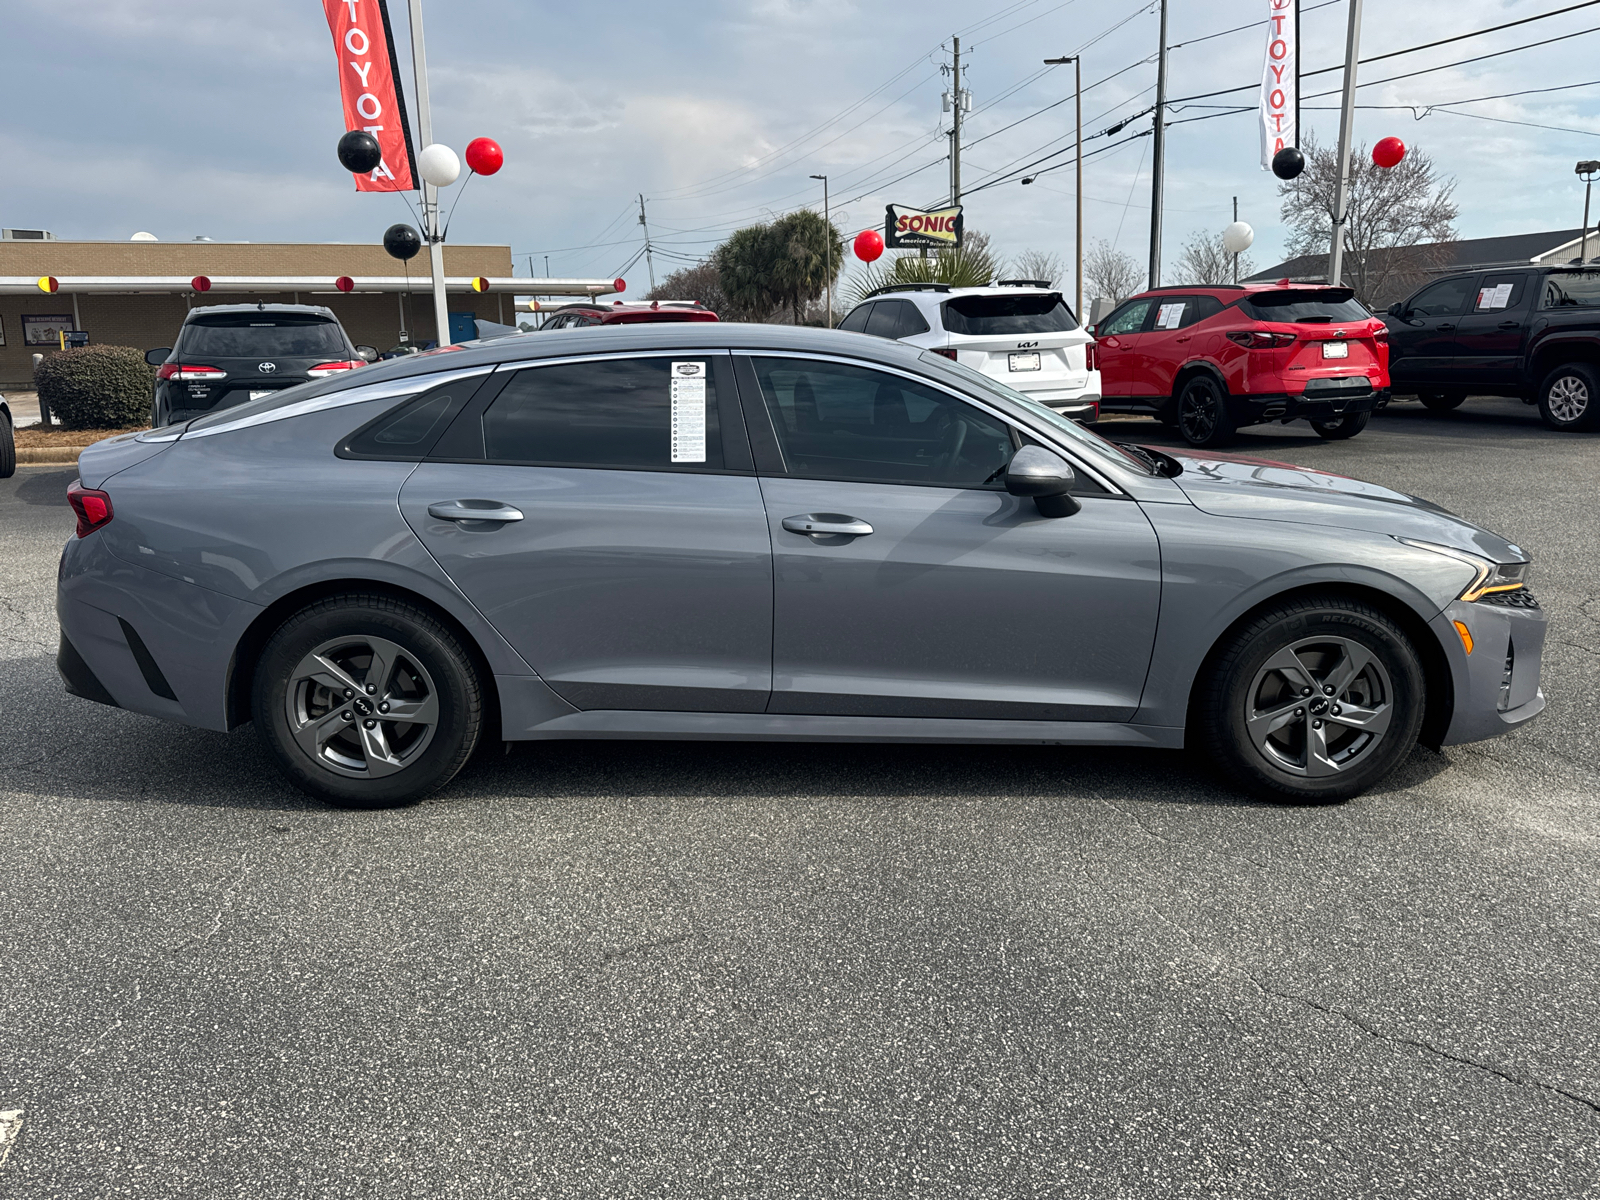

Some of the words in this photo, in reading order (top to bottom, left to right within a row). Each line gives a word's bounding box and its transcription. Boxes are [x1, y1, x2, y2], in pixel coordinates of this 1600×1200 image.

[1269, 15, 1287, 157] TOYOTA
[897, 215, 957, 232] SONIC
[1017, 341, 1039, 349] KIA
[1321, 615, 1389, 641] RELIATREK
[1310, 700, 1328, 713] KIA
